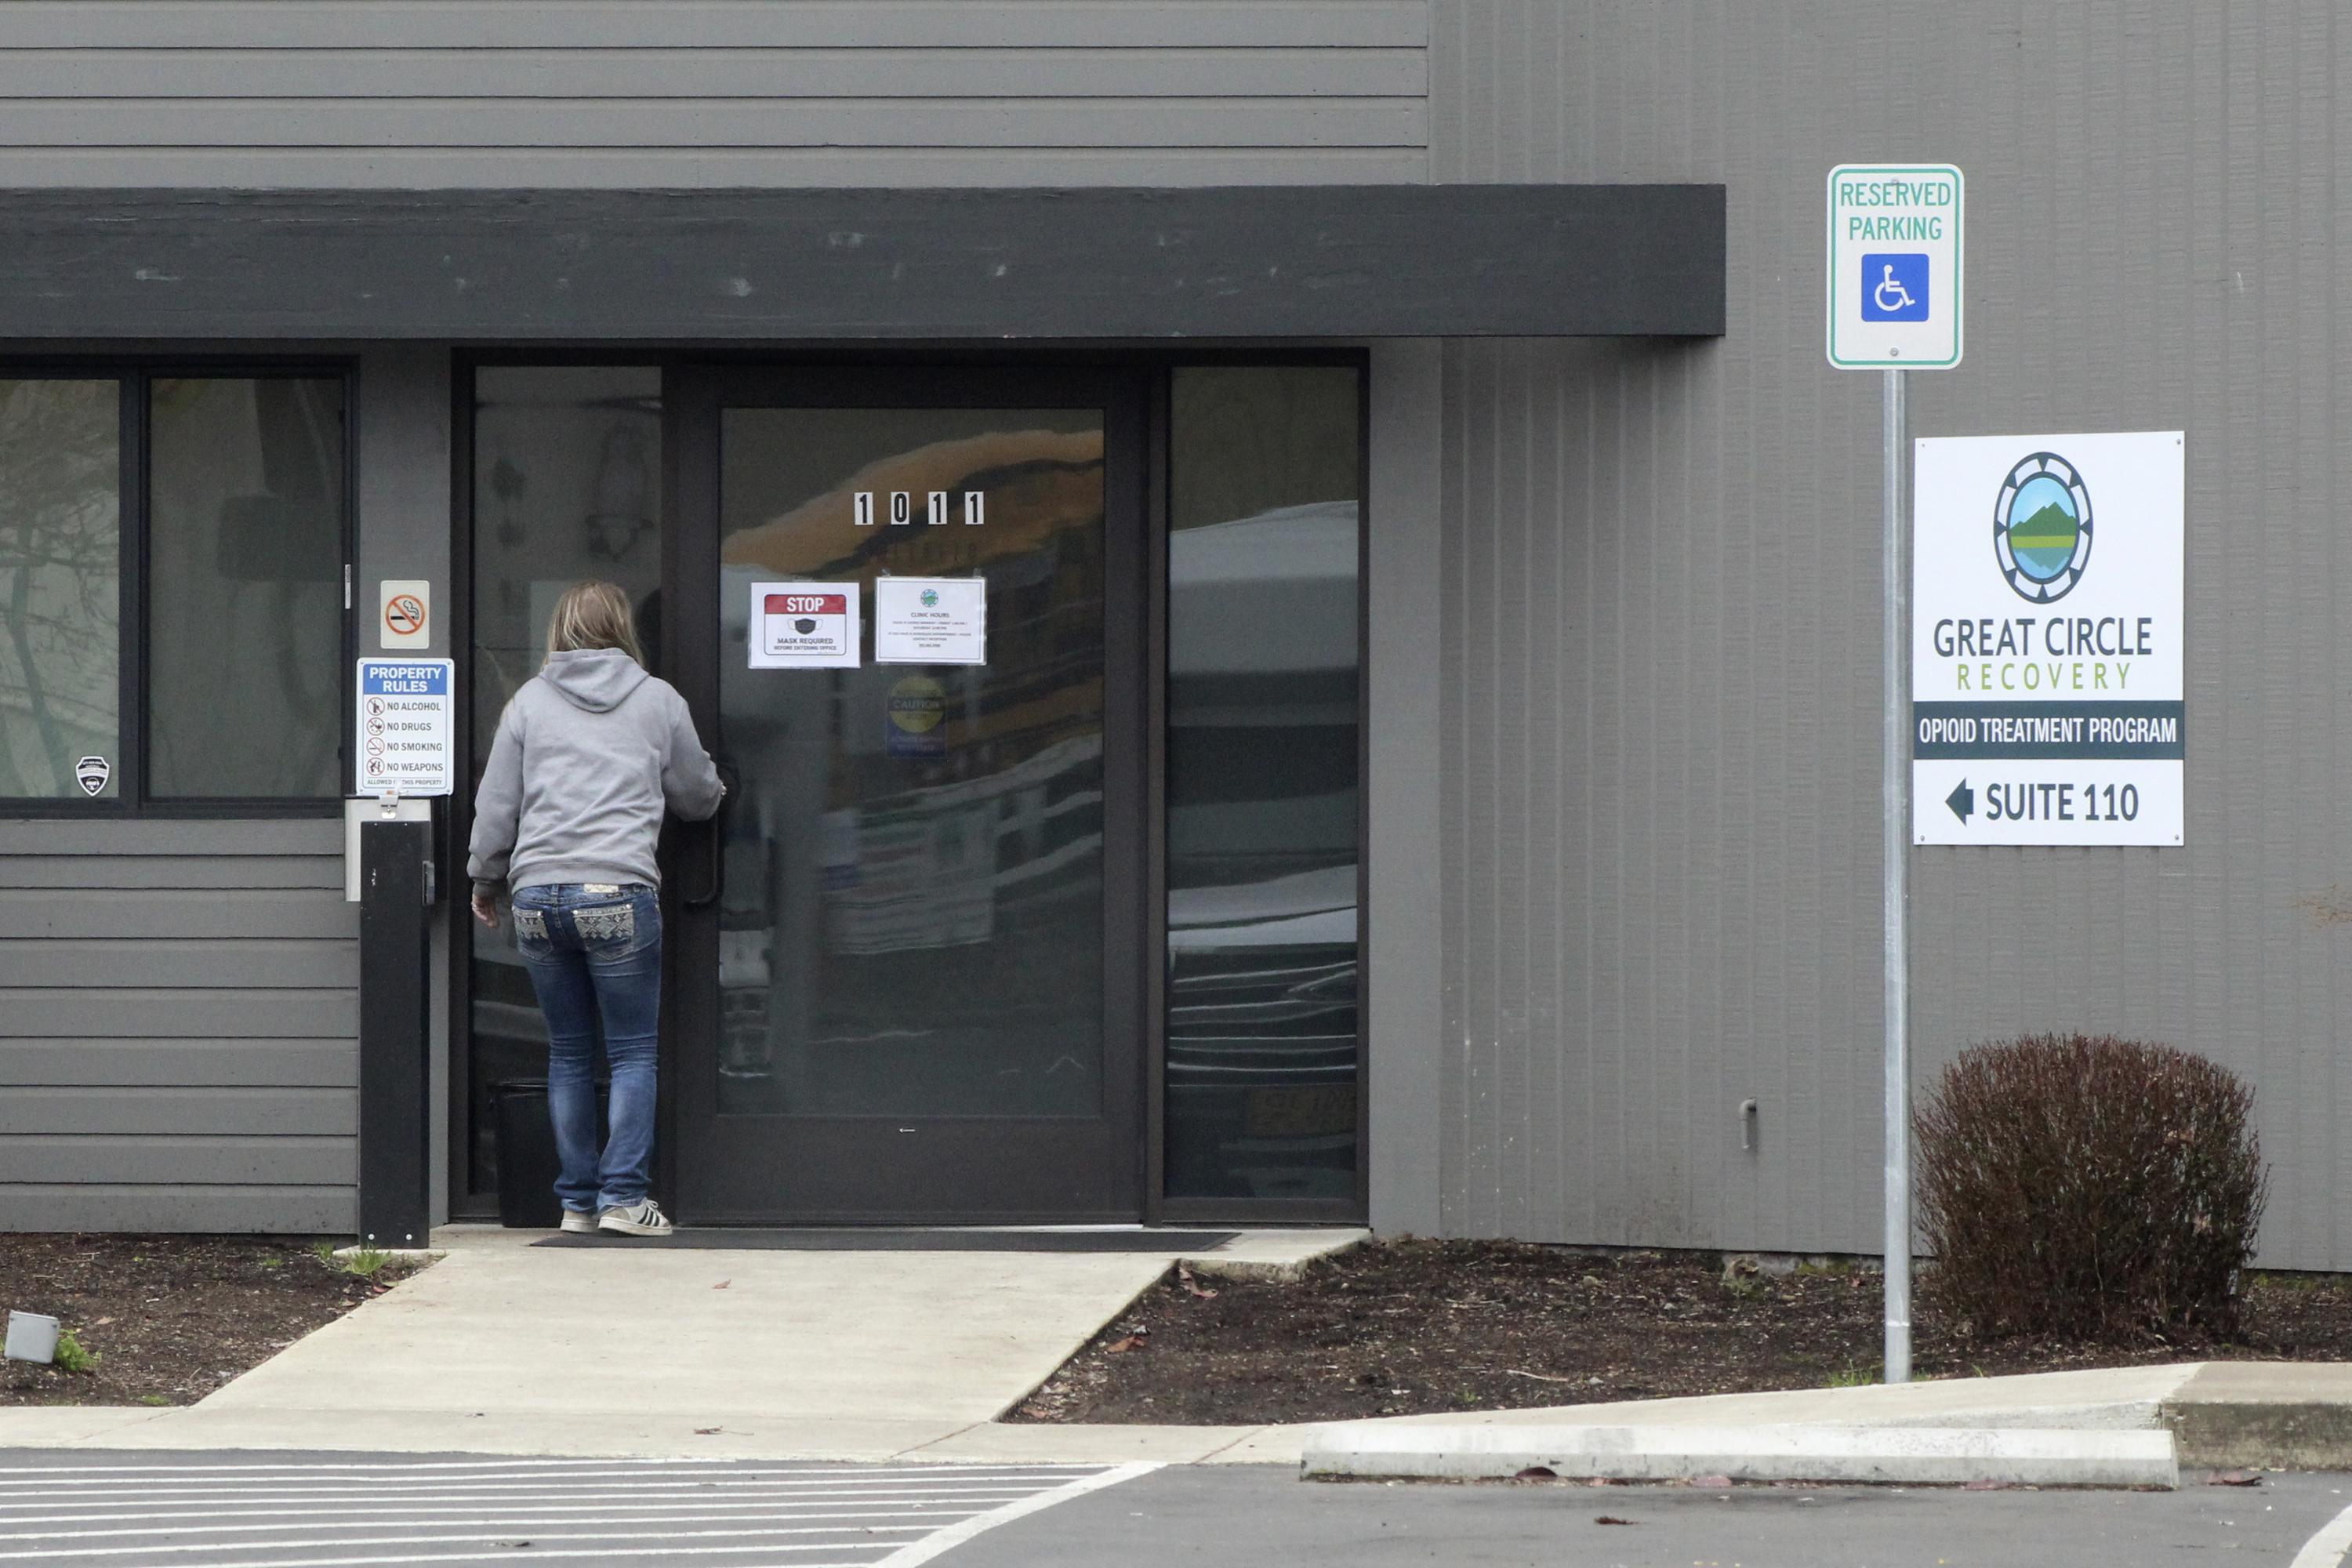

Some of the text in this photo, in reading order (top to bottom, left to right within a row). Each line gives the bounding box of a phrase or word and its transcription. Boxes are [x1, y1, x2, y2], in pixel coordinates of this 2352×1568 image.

[1840, 181, 1951, 207] RESERVED
[1849, 216, 1943, 241] PARKING
[786, 597, 825, 612] STOP
[1933, 617, 2153, 658] GREAT CIRCLE
[369, 666, 443, 680] PROPERTY
[1957, 662, 2131, 691] RECOVERY
[383, 680, 428, 693] RULES
[387, 702, 441, 711] NO ALCOHOL
[387, 722, 432, 731] NO DRUGS
[1919, 717, 2177, 743] OPIOID TREATMENT PROGRAM
[387, 742, 442, 752] NO SMOKING
[387, 762, 444, 771] NO WEAPONS
[1986, 782, 2140, 822] SUITE 110
